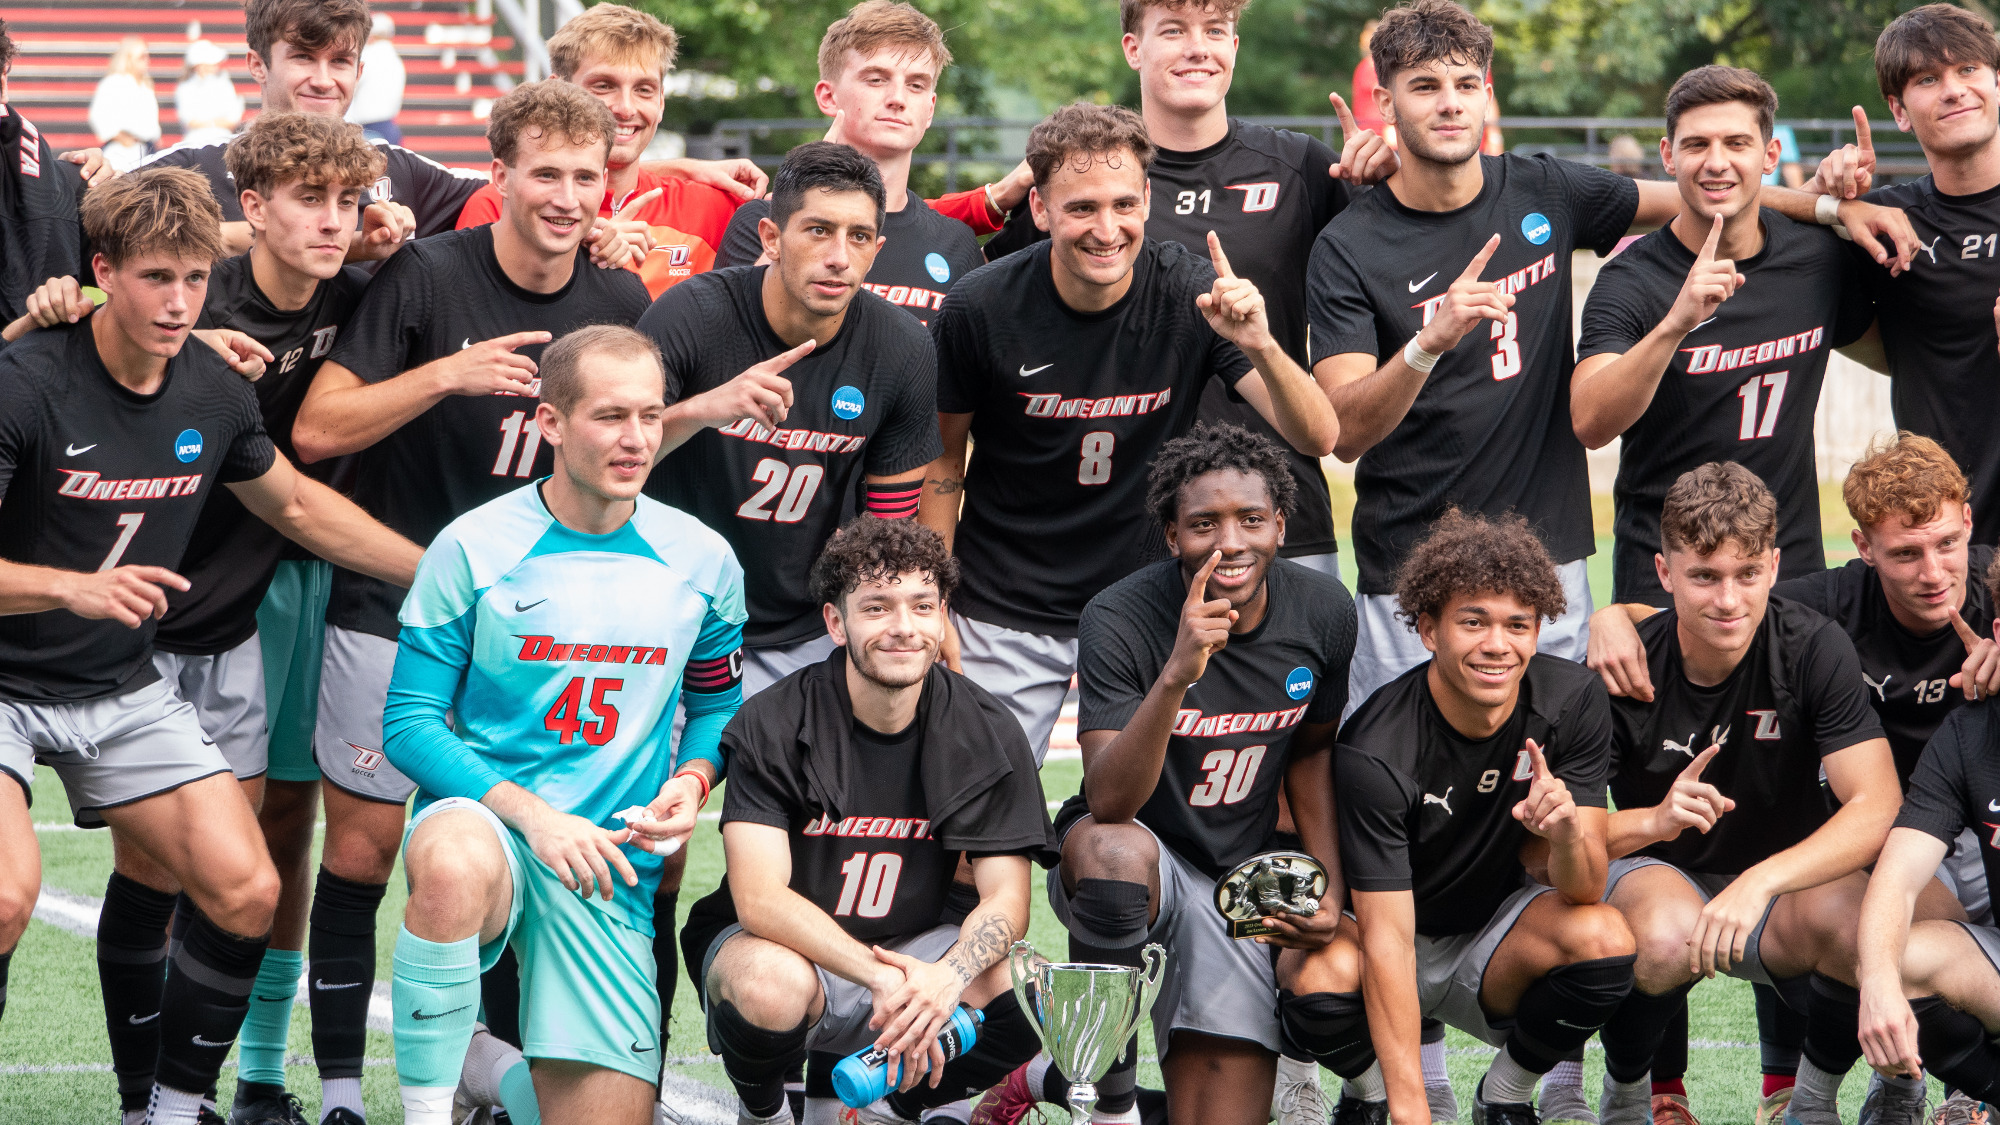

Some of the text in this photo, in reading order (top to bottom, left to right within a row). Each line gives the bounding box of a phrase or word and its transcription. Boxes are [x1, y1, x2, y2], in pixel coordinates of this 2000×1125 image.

[1175, 189, 1211, 215] 31
[1528, 223, 1550, 241] NCAA
[1961, 233, 1997, 259] 21
[669, 268, 690, 276] SOCCER
[1490, 310, 1522, 381] 3
[279, 346, 304, 374] 12
[835, 400, 861, 414] NCAA
[1737, 370, 1789, 440] 17
[178, 444, 201, 456] NCAA
[491, 410, 542, 478] 11
[1078, 431, 1115, 485] 8
[735, 457, 824, 523] 20
[729, 646, 743, 679] C
[1289, 681, 1311, 693] NCAA
[1913, 678, 1947, 704] 13
[544, 676, 624, 746] 45
[351, 767, 376, 779] SOCCER
[1189, 745, 1267, 807] 30
[1477, 769, 1500, 793] 9
[834, 851, 904, 918] 10
